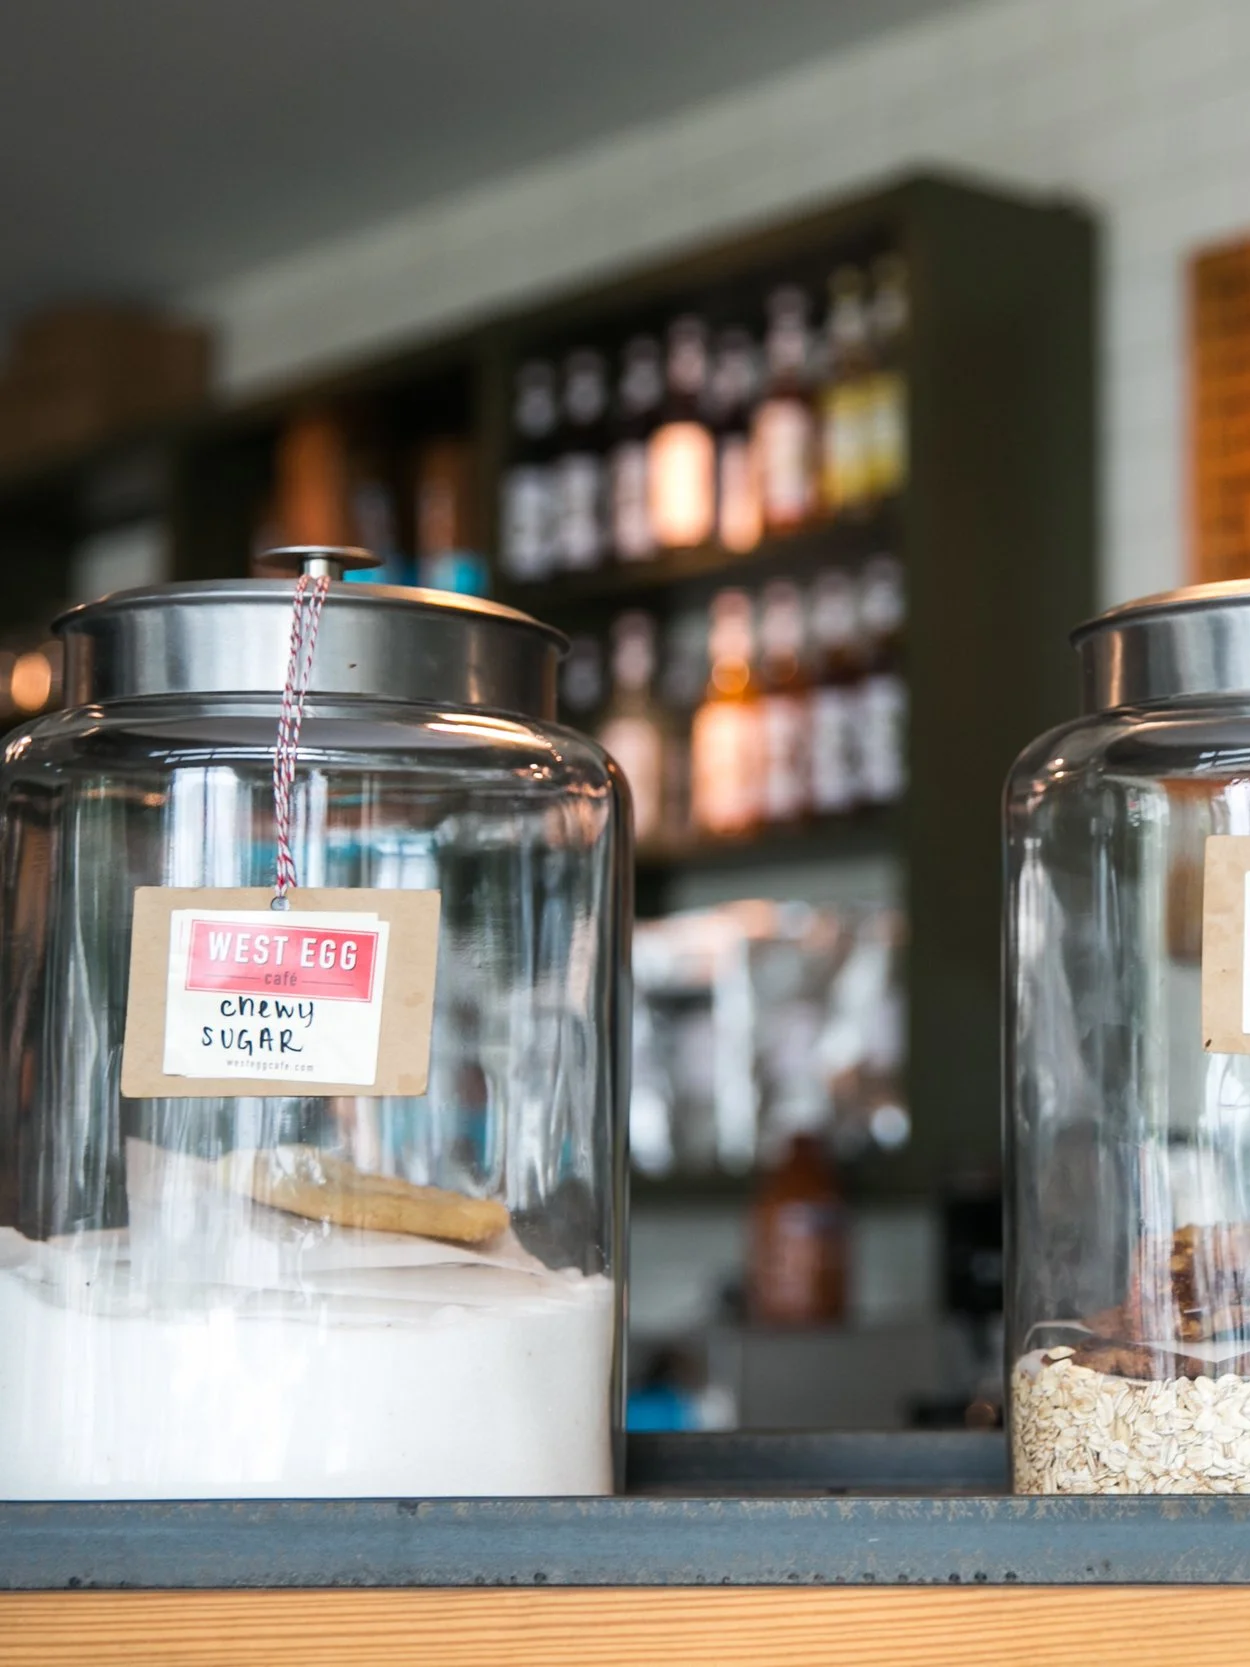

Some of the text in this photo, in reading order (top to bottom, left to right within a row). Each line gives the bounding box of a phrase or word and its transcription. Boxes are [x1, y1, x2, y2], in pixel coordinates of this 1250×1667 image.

[208, 931, 359, 971] WEST EGG
[264, 970, 298, 987] café
[201, 1026, 304, 1056] SUGAR
